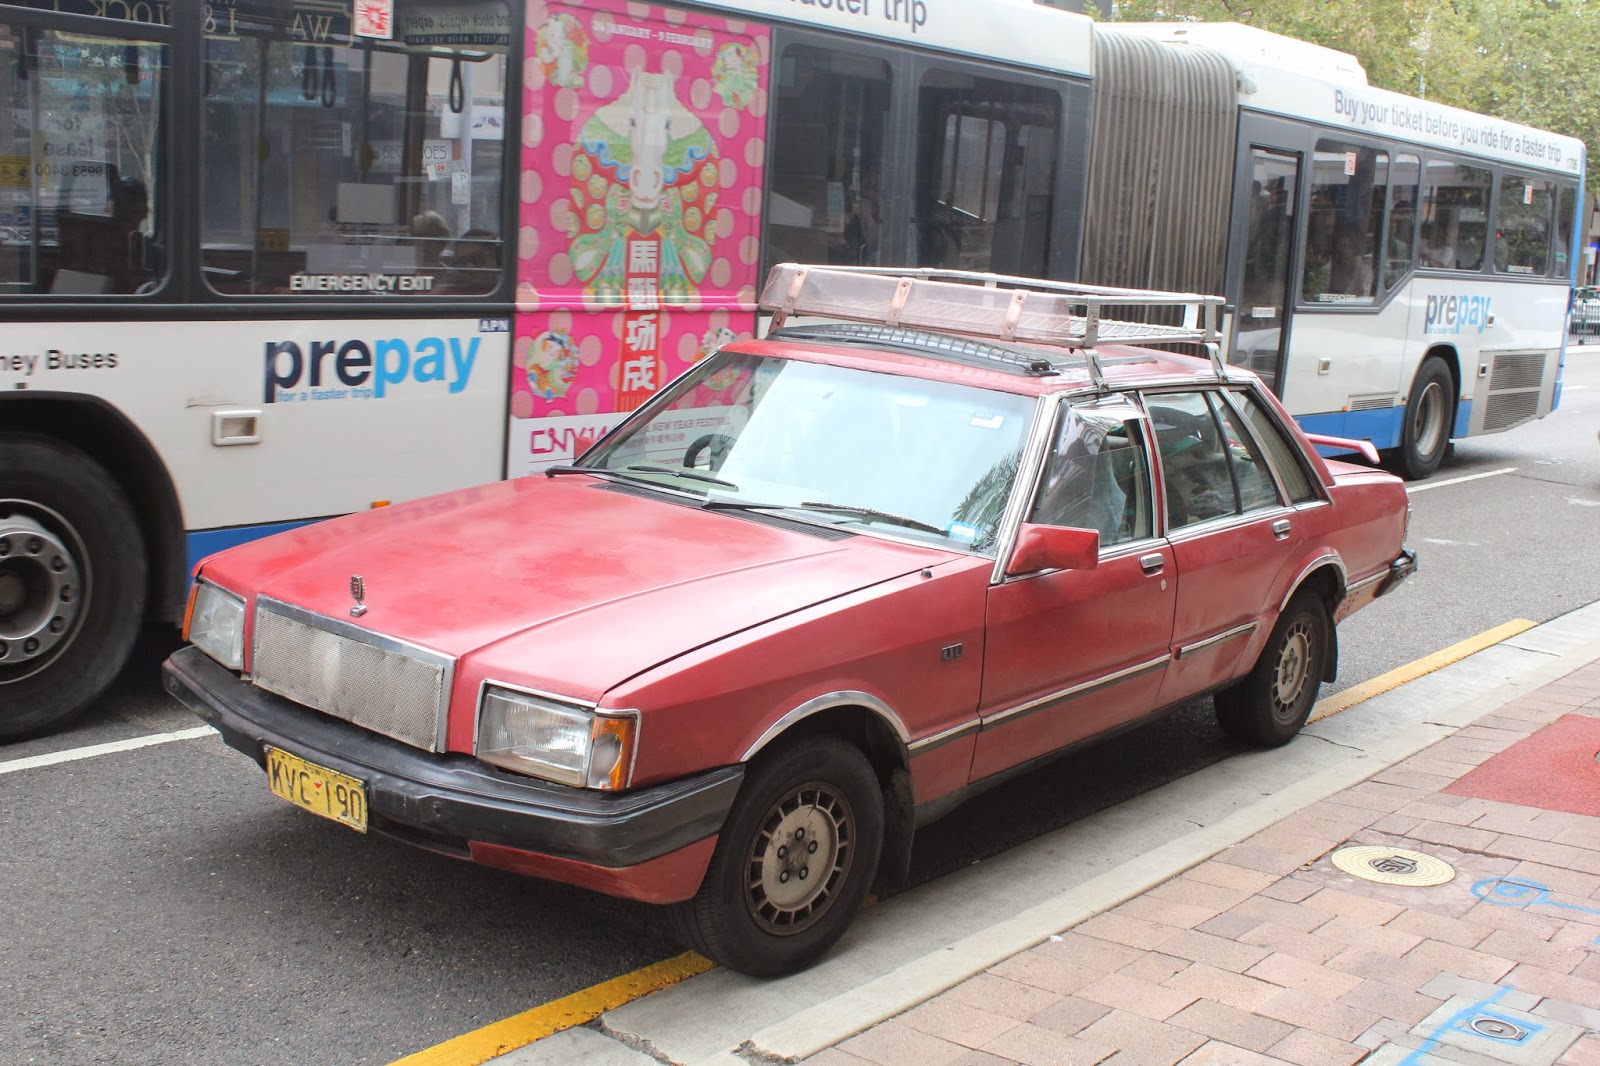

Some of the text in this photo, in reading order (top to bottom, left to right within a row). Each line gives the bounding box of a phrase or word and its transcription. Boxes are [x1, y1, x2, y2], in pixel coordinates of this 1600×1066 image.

[1334, 89, 1562, 165] Buy your ticket before you ride for a faster trip
[290, 273, 435, 291] EMERGENCY EXIT
[479, 318, 510, 332] APN
[1424, 294, 1492, 335] prepay
[46, 349, 120, 370] Buses
[263, 336, 482, 405] prepay
[311, 388, 348, 401] faster
[351, 386, 373, 400] trip
[270, 757, 363, 824] KVC 190
